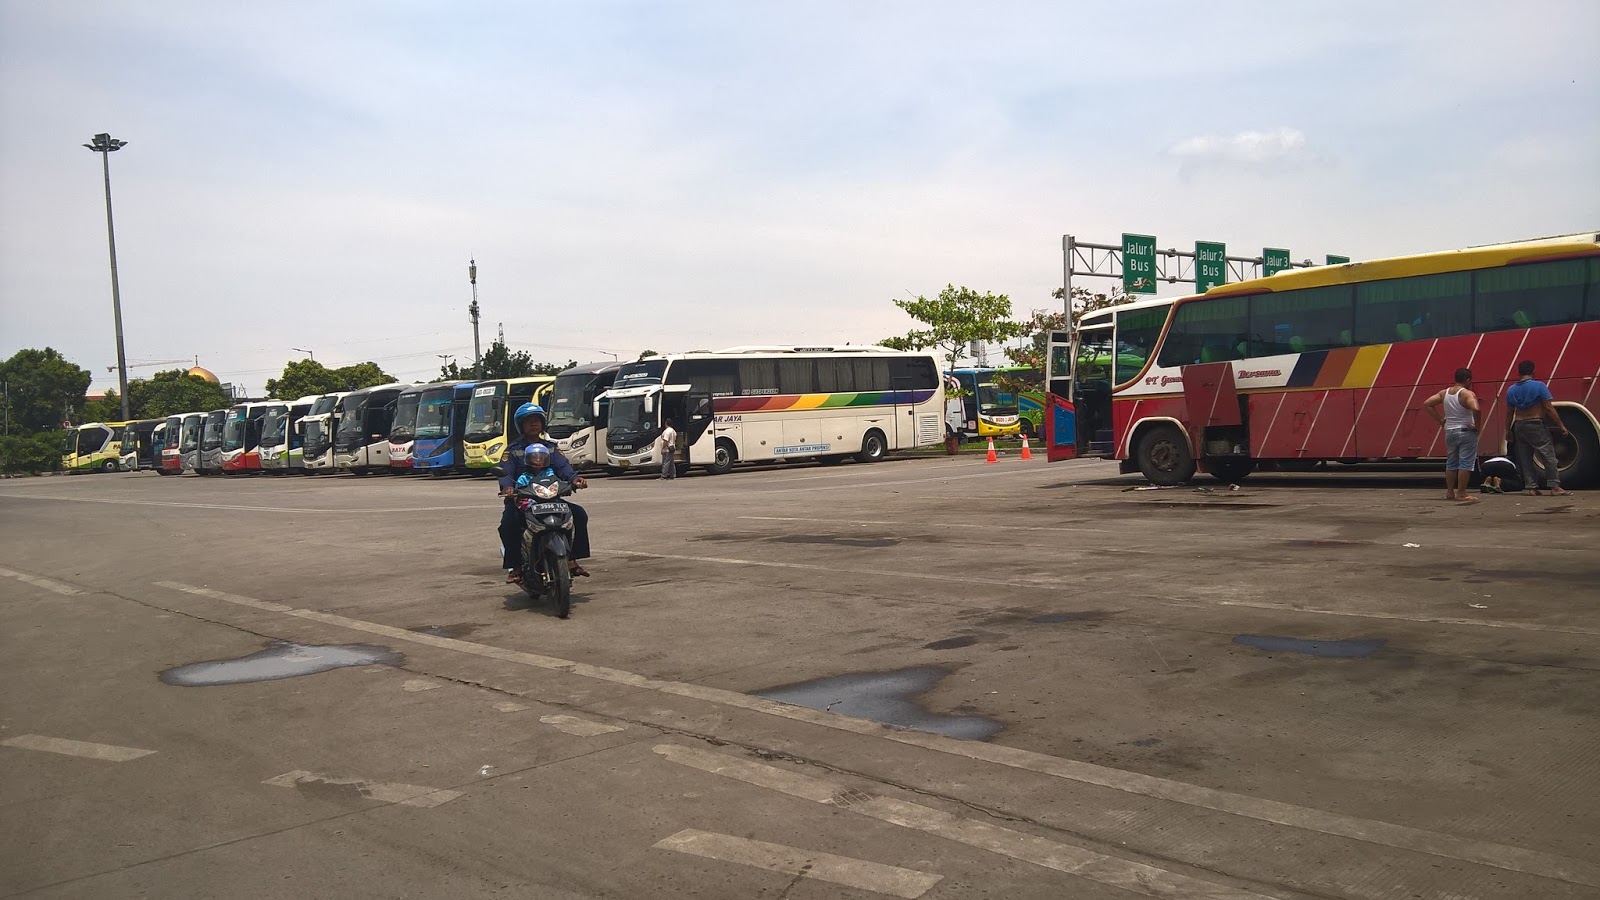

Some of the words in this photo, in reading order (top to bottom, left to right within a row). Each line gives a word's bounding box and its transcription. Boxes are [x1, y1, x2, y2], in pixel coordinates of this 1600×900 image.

[1126, 242, 1147, 256] Jalur
[1150, 244, 1154, 257] 1
[1198, 249, 1218, 261] Jalur
[1218, 250, 1224, 262] 2
[1130, 258, 1149, 272] Bus
[1266, 255, 1282, 267] Jalur
[1283, 256, 1289, 268] 3
[1202, 264, 1219, 277] Bus
